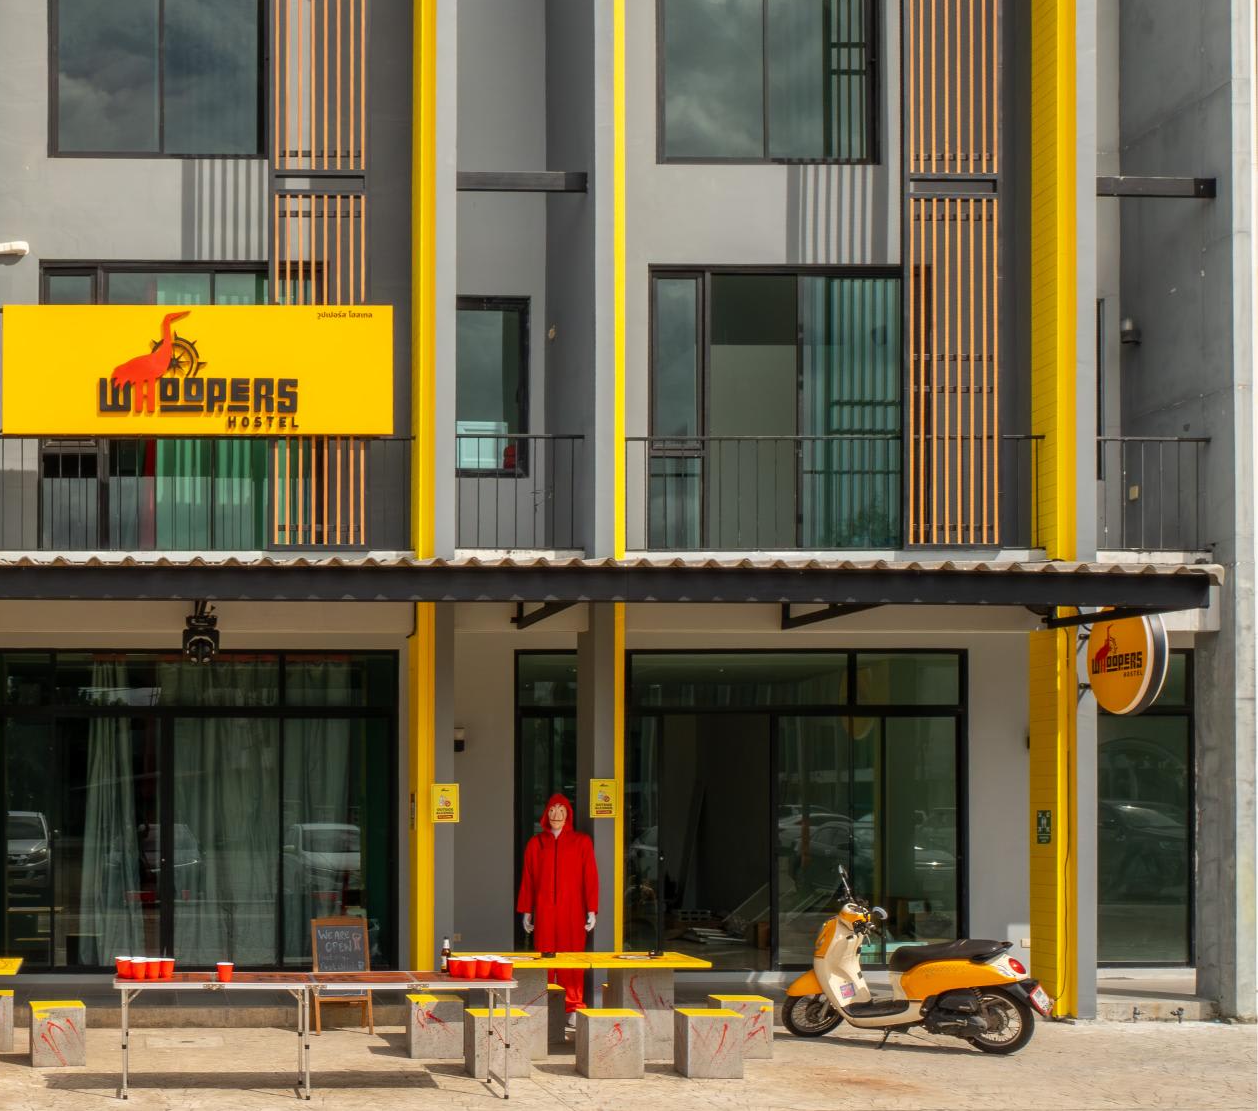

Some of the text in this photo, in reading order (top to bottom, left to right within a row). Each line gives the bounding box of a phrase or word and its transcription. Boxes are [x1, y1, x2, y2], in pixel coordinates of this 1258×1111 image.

[98, 377, 298, 413] WHOOPERS
[228, 416, 299, 428] HOSTEL
[1091, 651, 1143, 675] WHOOPERS
